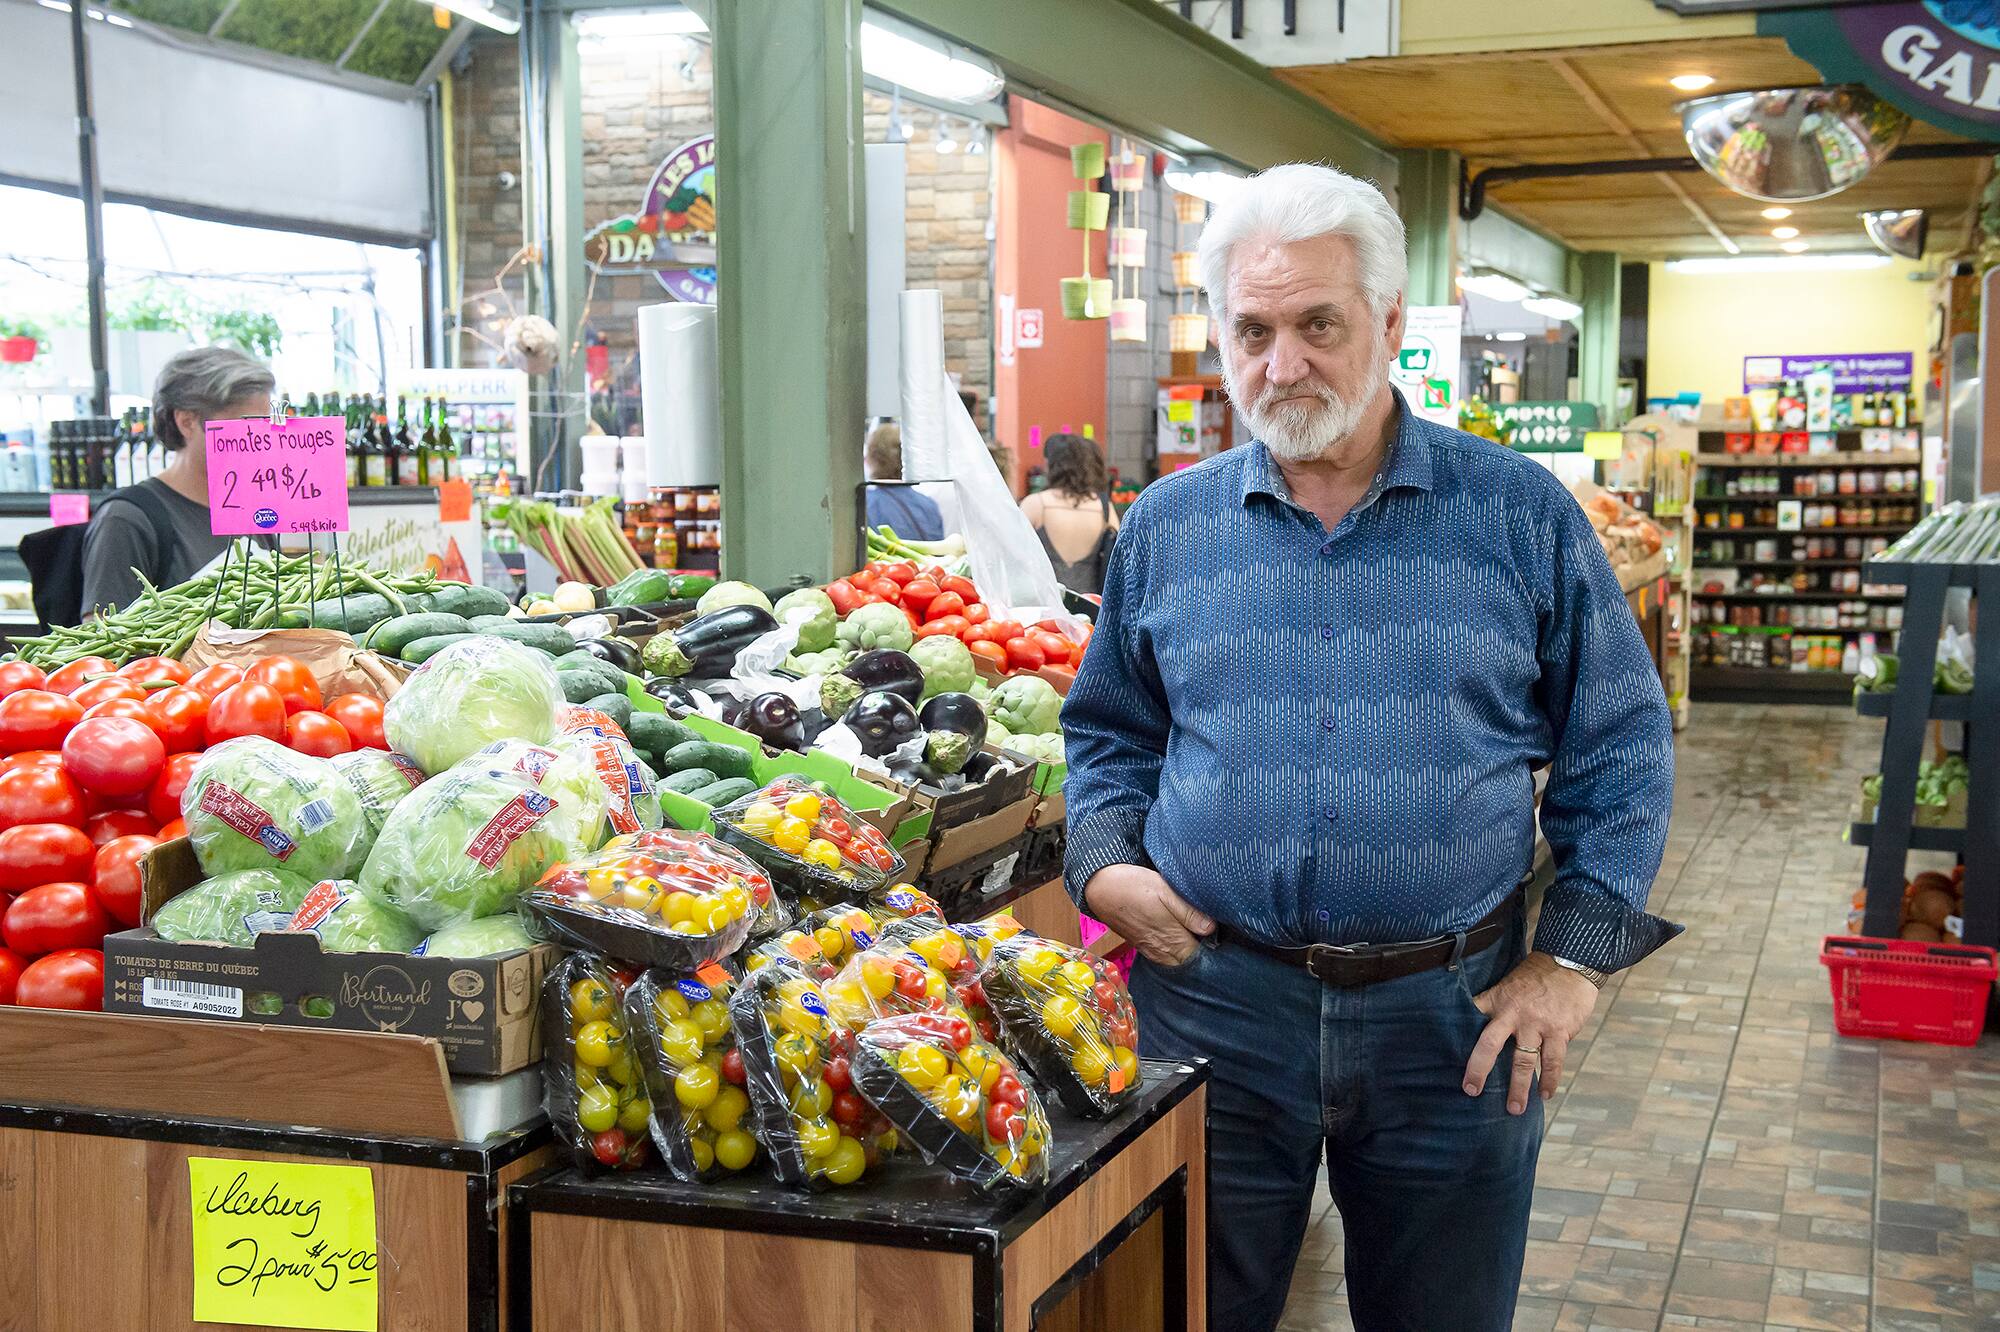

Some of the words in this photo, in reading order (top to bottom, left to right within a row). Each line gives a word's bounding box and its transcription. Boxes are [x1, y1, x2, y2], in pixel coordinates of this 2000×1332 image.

[656, 153, 695, 198] LES
[207, 425, 272, 454] Tomates
[278, 429, 335, 454] rouges
[115, 955, 157, 968] TOMATES
[159, 959, 171, 969] DE
[173, 960, 204, 972] SERRE
[206, 962, 219, 973] DU
[221, 963, 260, 976] QUÉBEC
[136, 969, 146, 977] LB
[129, 982, 144, 991] ROS
[340, 972, 432, 1008] Bertrand
[151, 997, 169, 1007] TOMATE
[192, 1002, 238, 1015] A09052022
[206, 1172, 322, 1238] Iceberg
[217, 1238, 258, 1287] 2
[252, 1257, 315, 1297] pour
